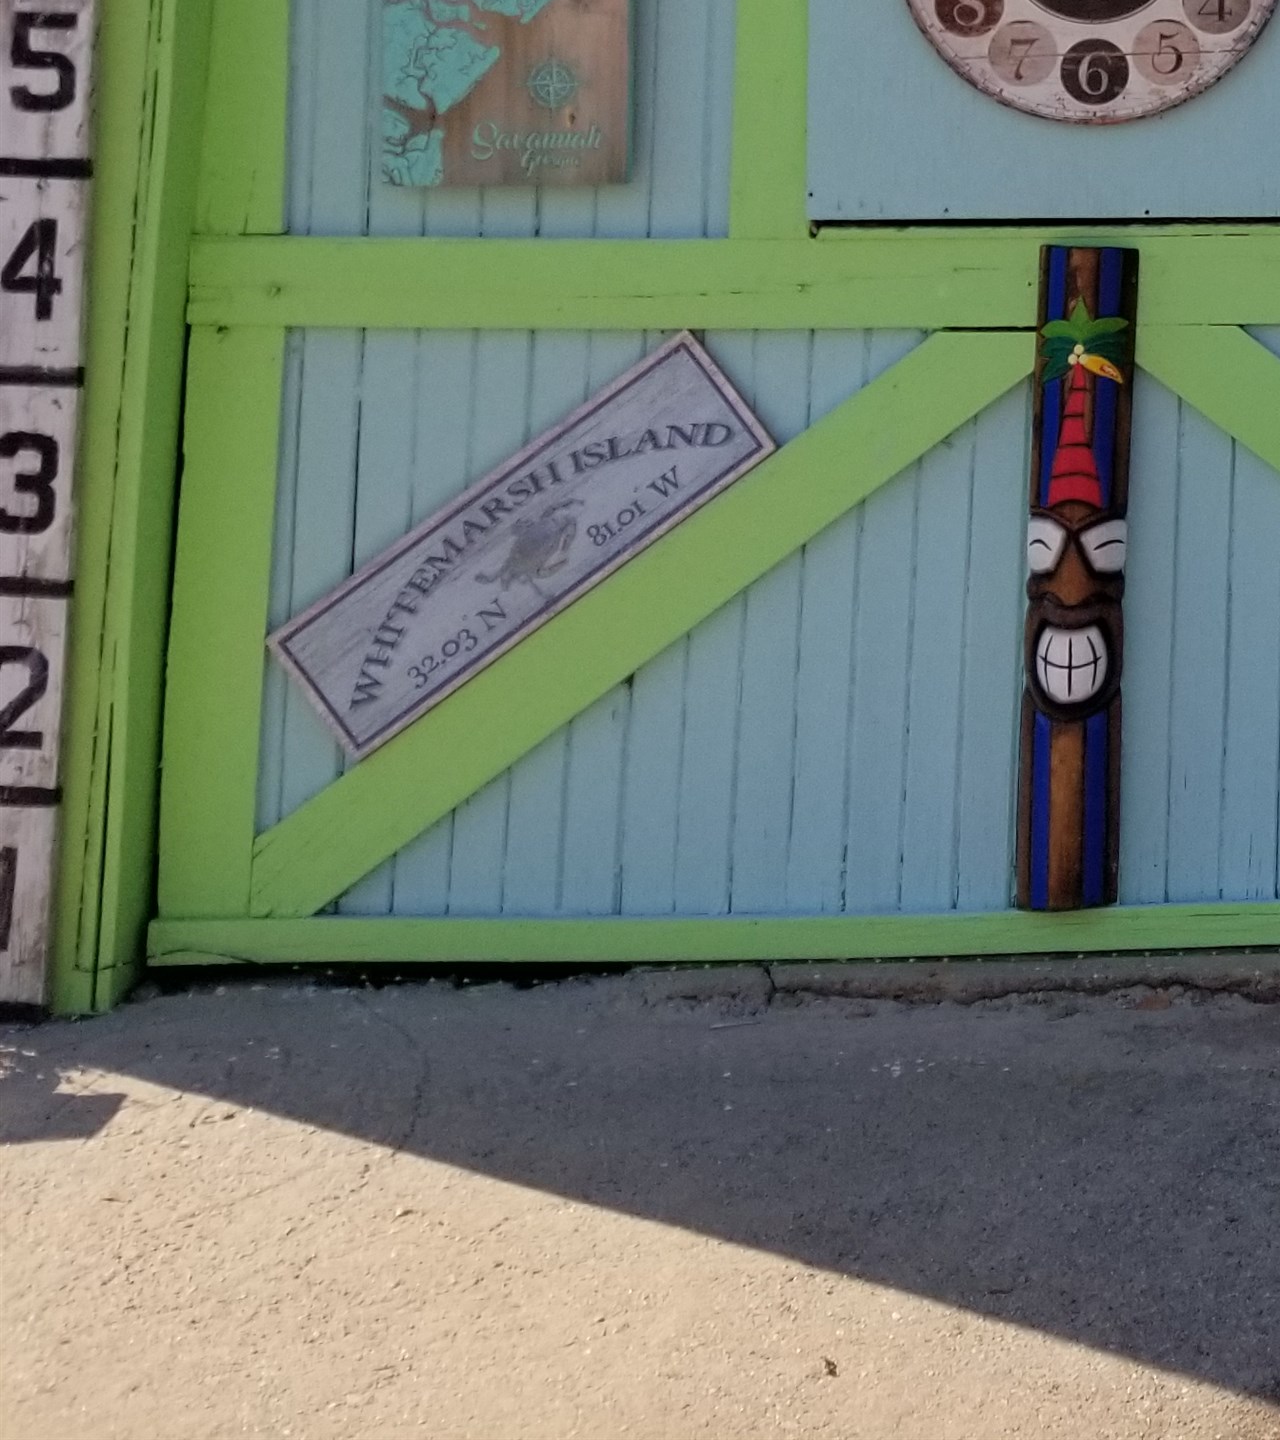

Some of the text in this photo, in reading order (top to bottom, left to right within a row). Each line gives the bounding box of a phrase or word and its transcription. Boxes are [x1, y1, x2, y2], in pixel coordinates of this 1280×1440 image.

[8, 11, 78, 113] 5
[1008, 37, 1040, 81] 7
[1078, 50, 1110, 96] 6
[1150, 33, 1183, 75] 5
[0, 218, 62, 321] 4
[0, 430, 58, 535] 3
[645, 464, 679, 498] W
[349, 421, 733, 712] WHITEMARSH ISLAND
[475, 598, 507, 632] N
[0, 644, 48, 750] 2
